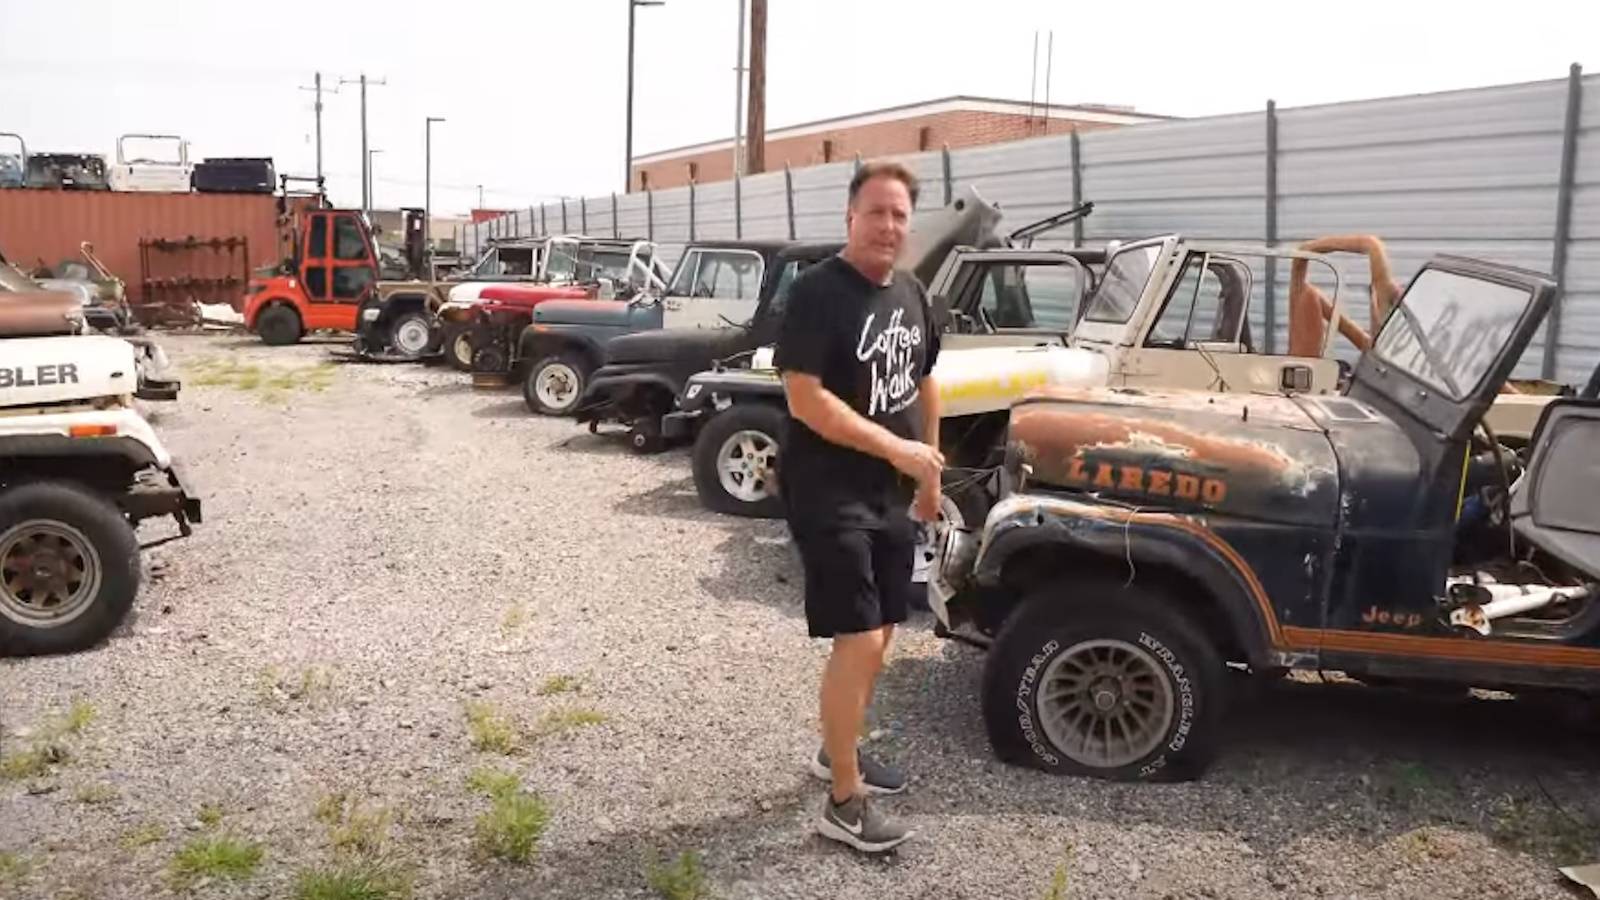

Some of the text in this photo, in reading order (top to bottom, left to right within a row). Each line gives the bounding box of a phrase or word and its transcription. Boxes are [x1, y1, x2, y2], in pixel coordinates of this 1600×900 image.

[0, 364, 78, 387] BLER
[868, 352, 915, 416] Walk
[1069, 457, 1227, 504] LAREDO
[1362, 605, 1423, 627] Jeep
[1017, 640, 1060, 766] GOODYEAR
[1138, 632, 1193, 752] WRANGLER
